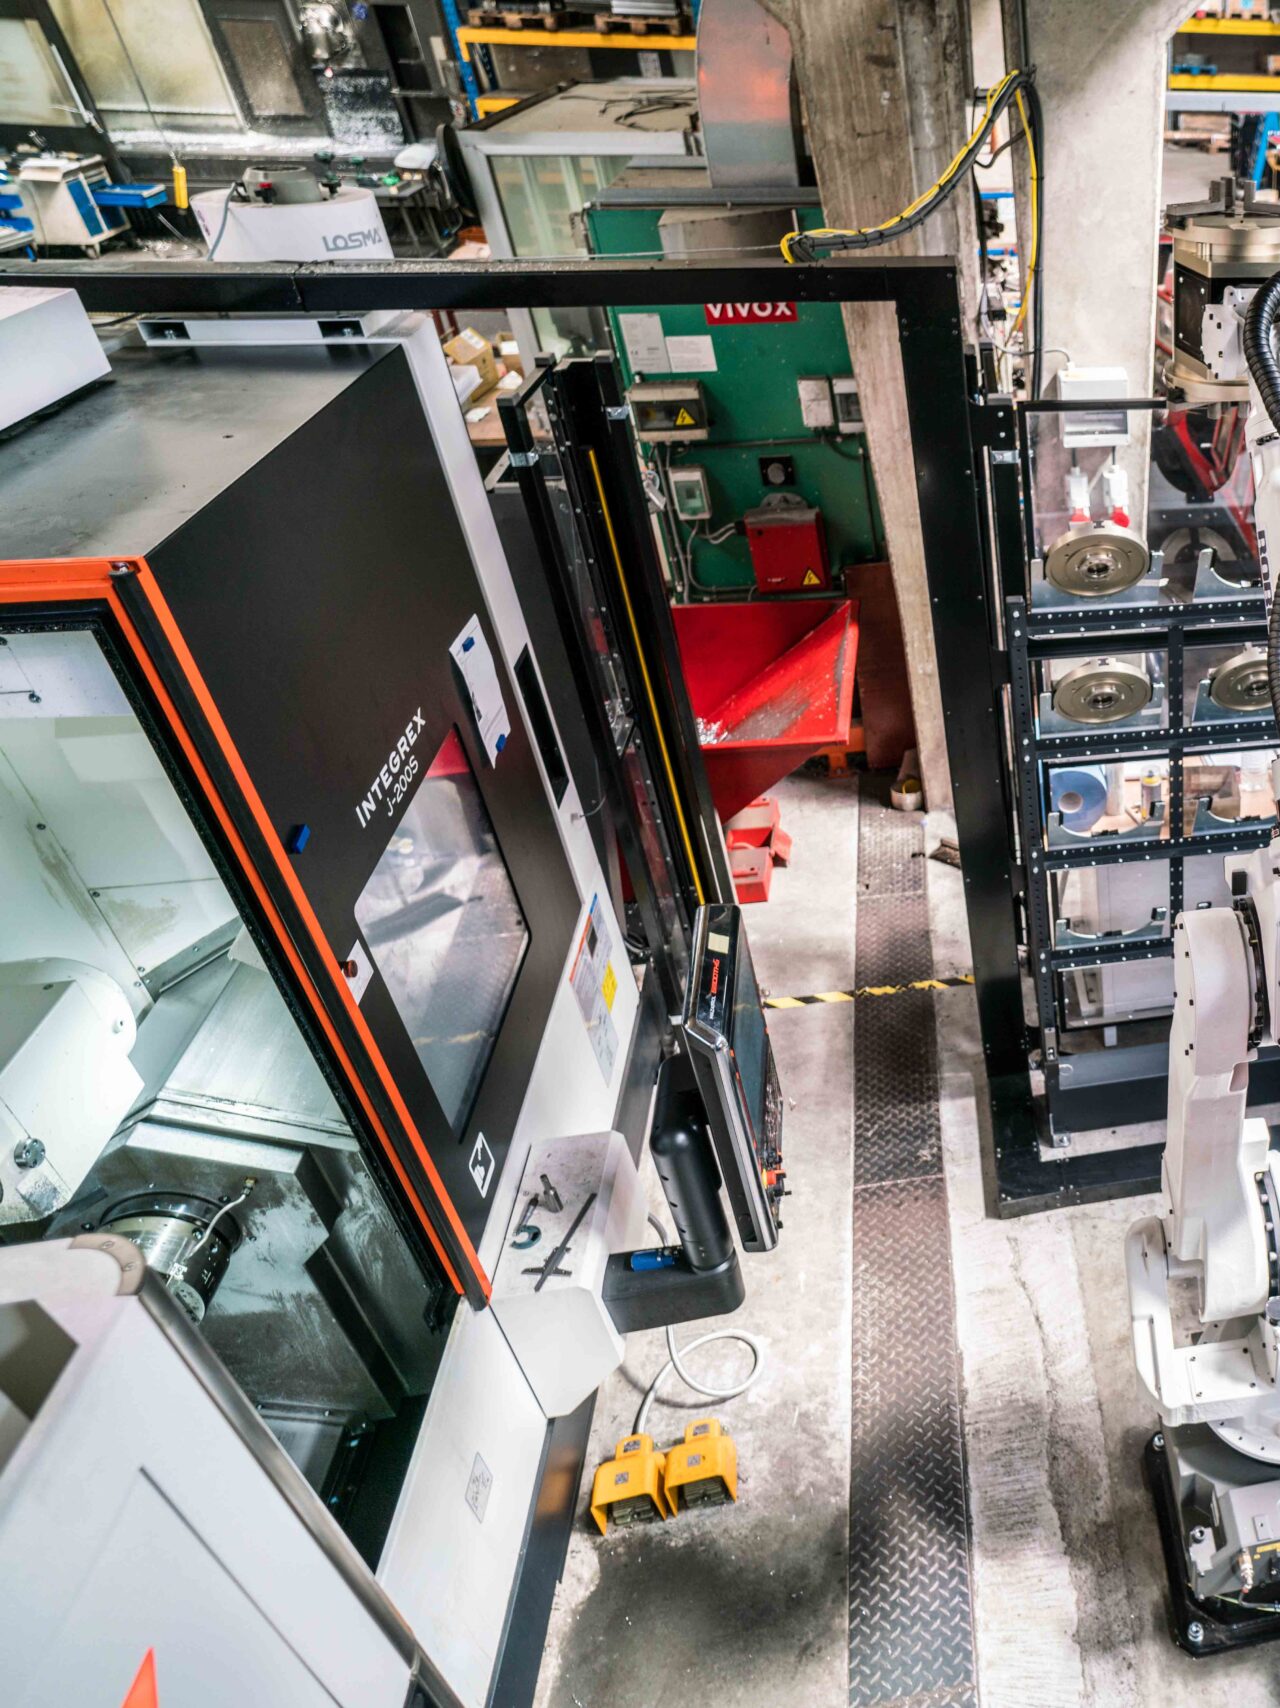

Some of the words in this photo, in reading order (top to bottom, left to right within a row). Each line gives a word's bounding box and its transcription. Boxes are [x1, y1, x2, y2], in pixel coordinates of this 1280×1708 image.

[322, 227, 383, 252] LOSMA
[706, 302, 792, 319] VIVOX
[355, 706, 426, 829] INTEGREX
